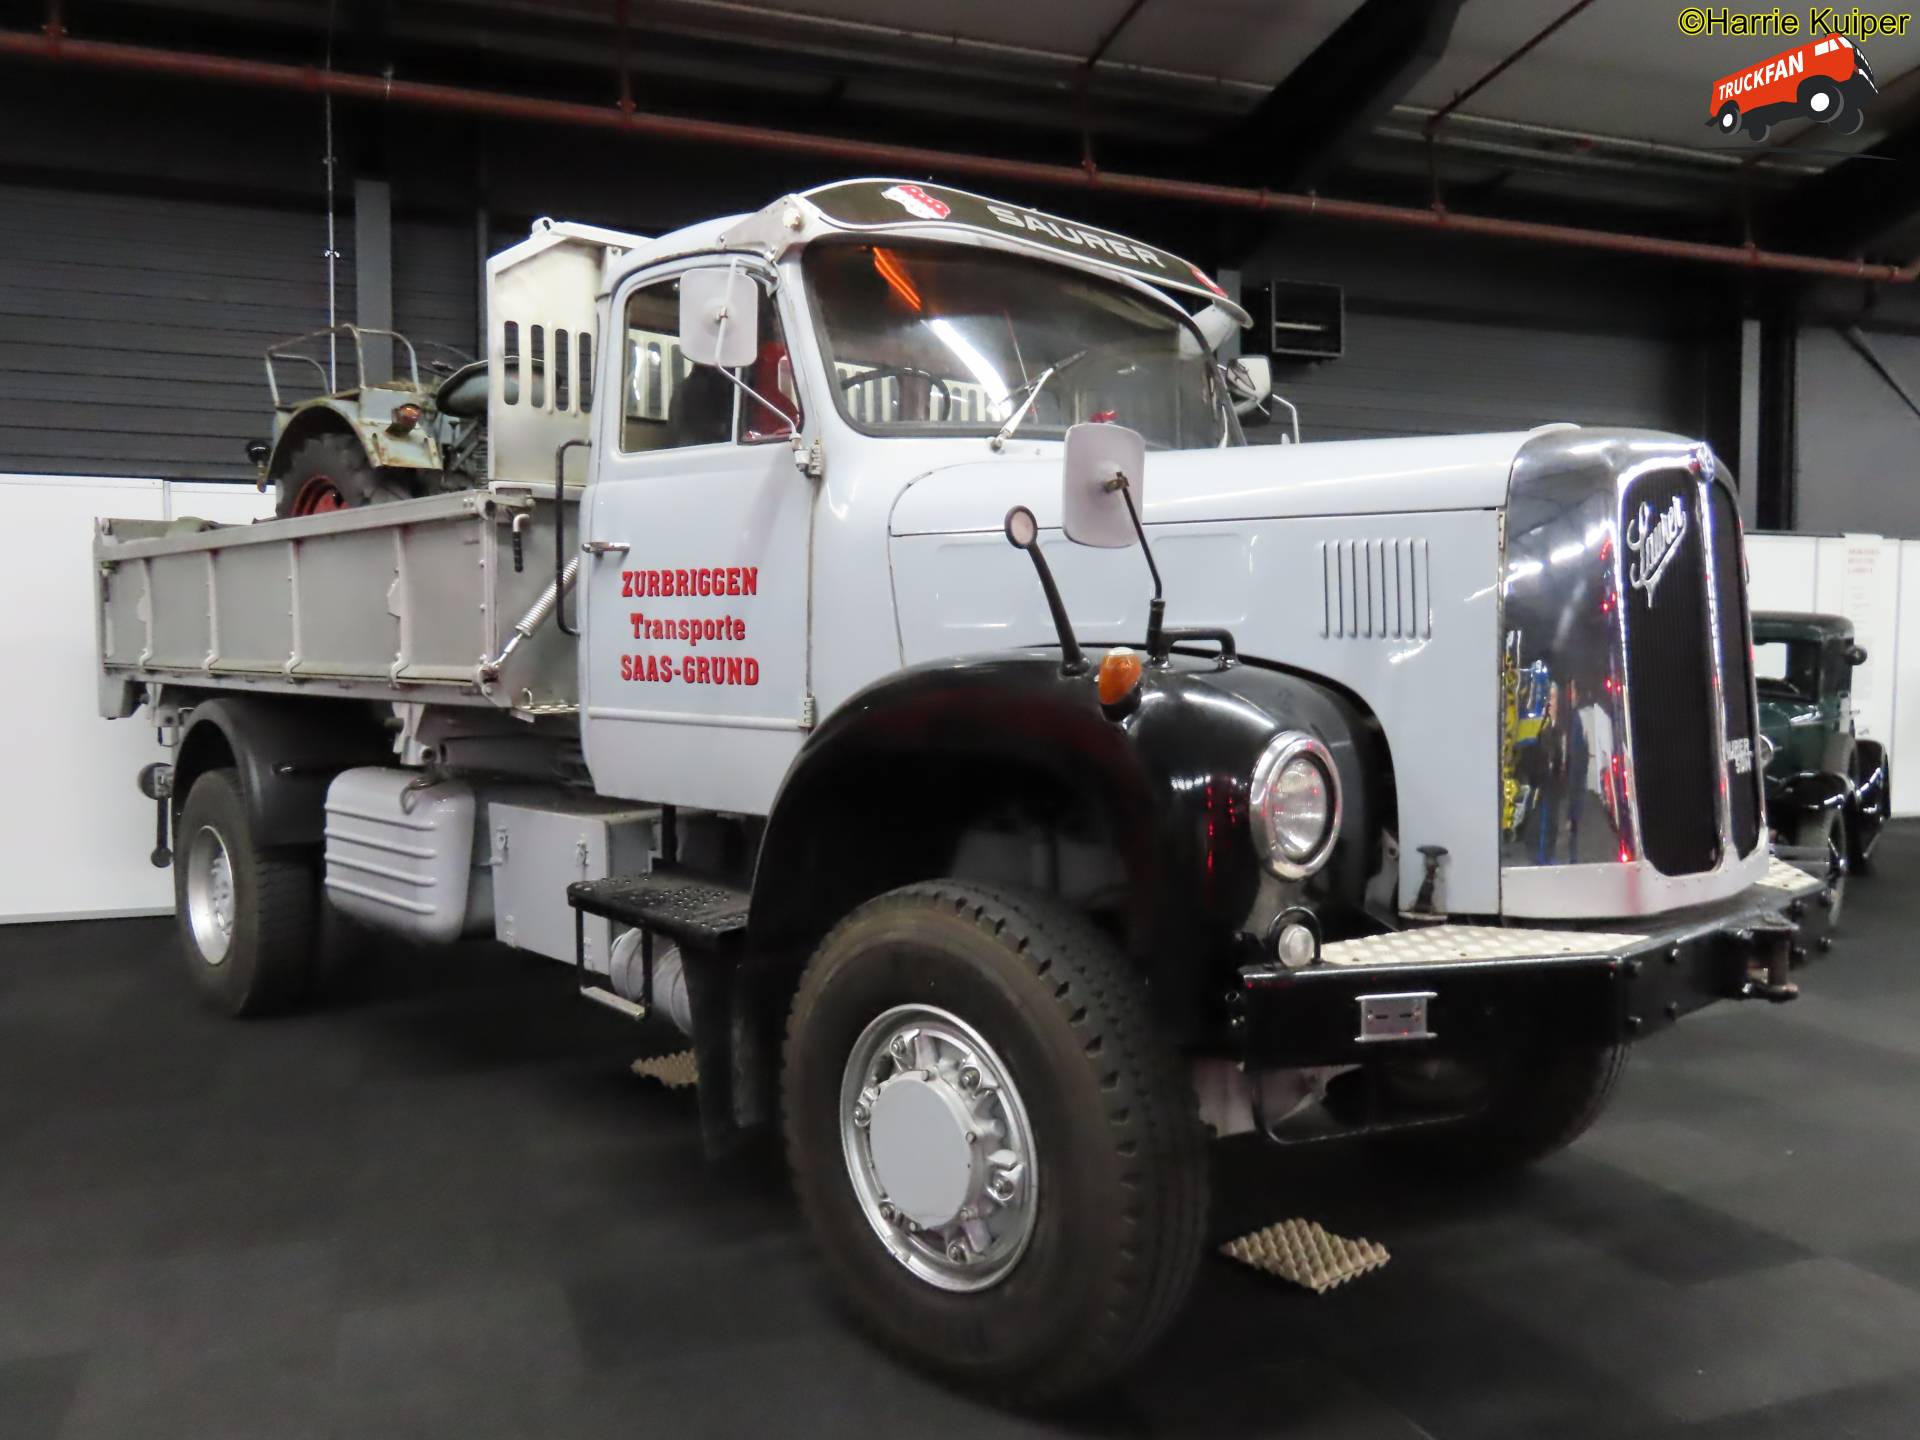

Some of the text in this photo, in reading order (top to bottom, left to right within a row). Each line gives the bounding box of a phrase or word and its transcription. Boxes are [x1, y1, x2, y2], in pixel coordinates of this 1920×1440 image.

[986, 204, 1167, 269] SAURER
[621, 566, 758, 598] ZURBRIGGEN
[630, 612, 746, 647] Transporte
[620, 653, 760, 686] SAAS-GRUND
